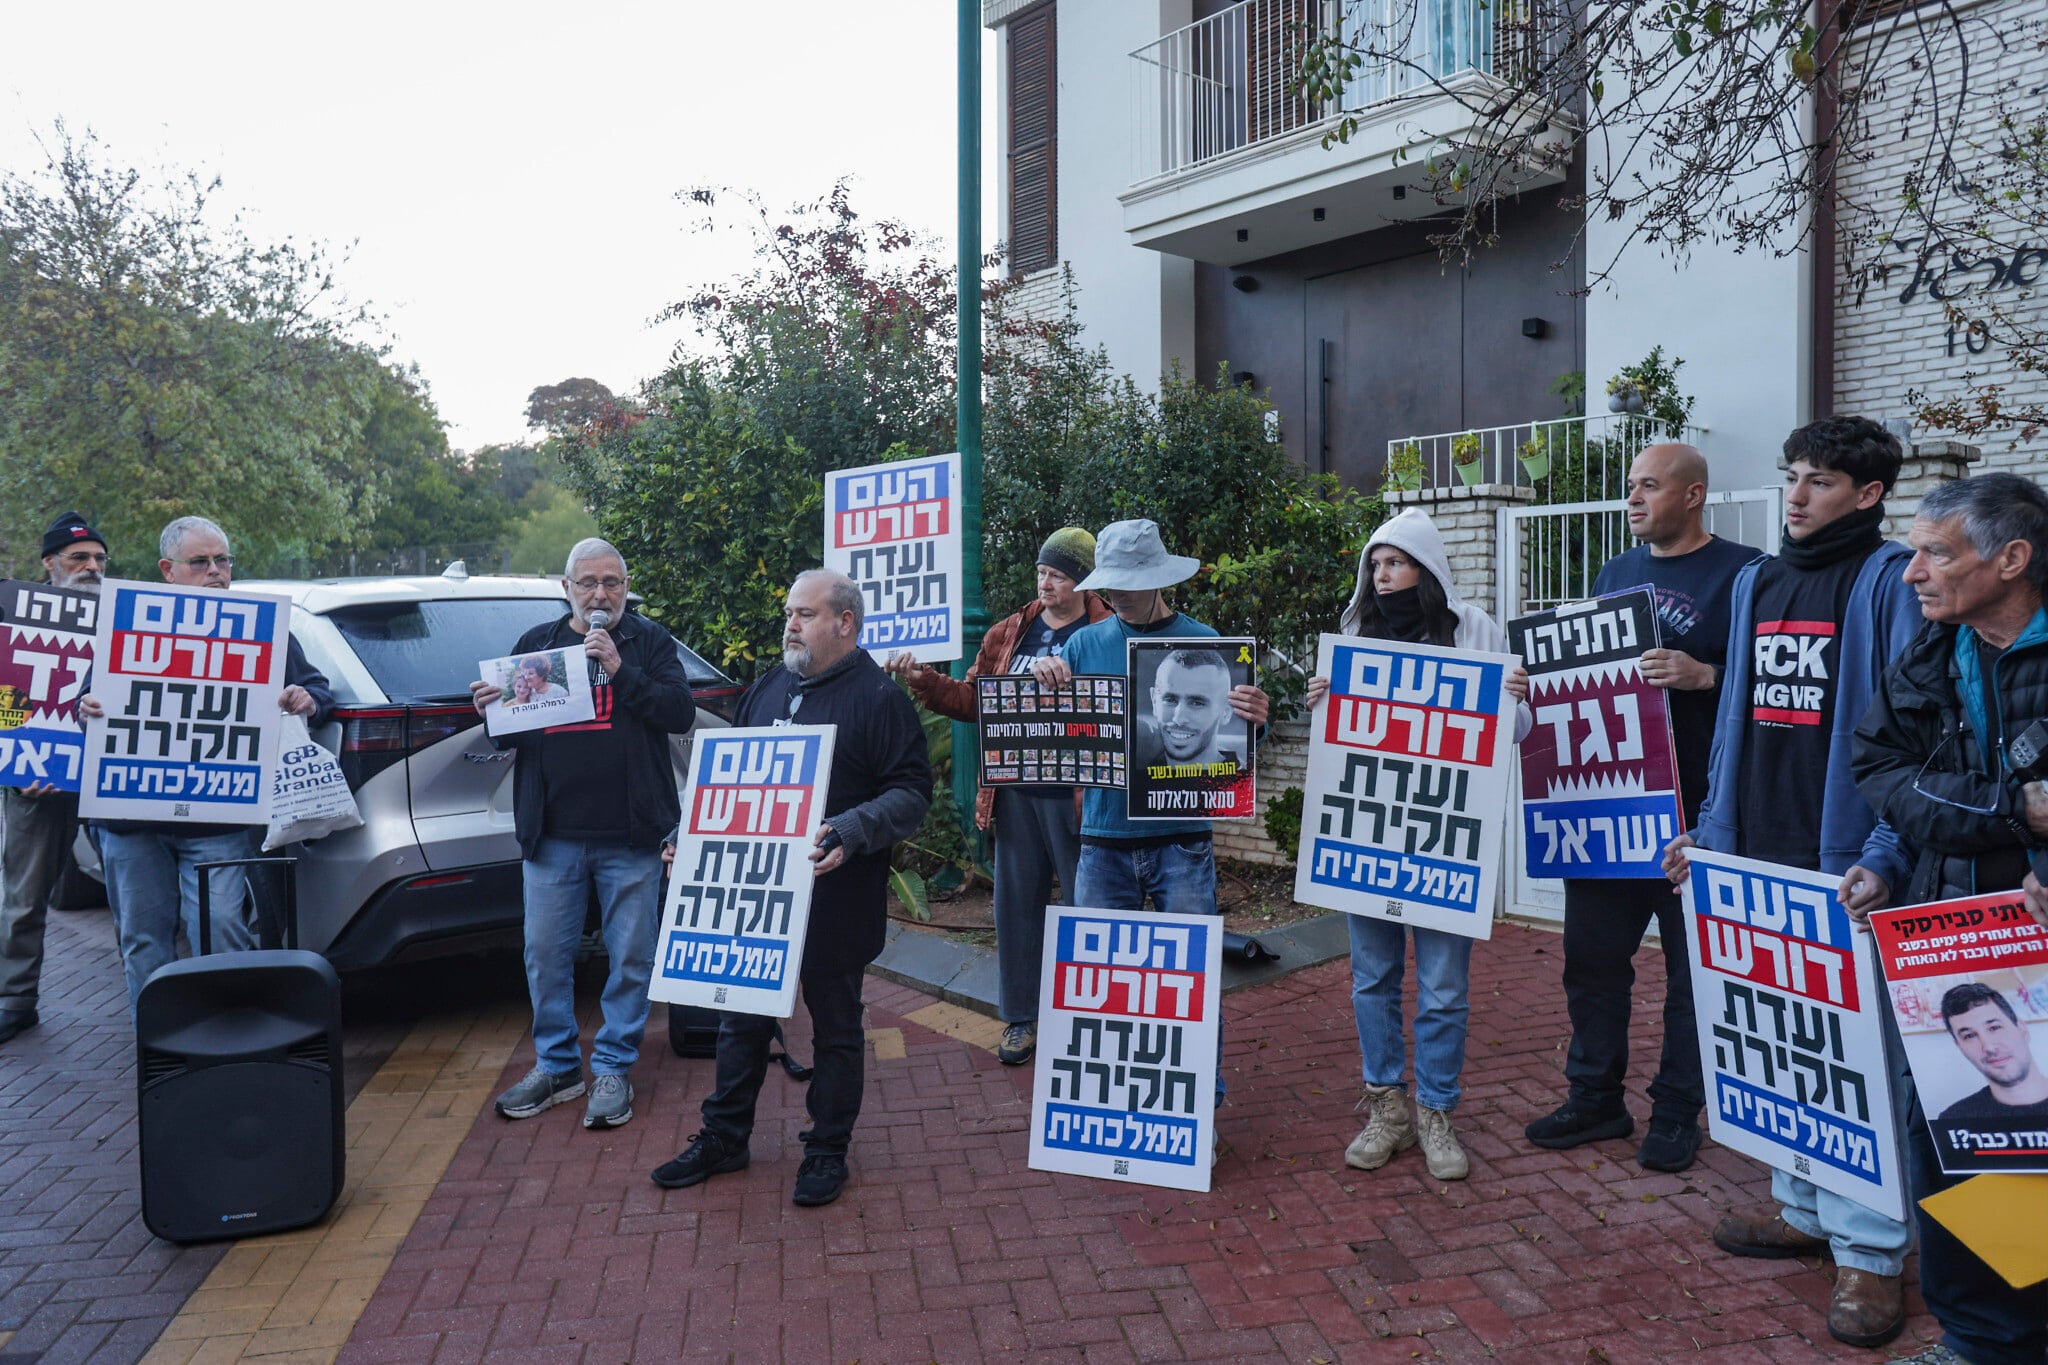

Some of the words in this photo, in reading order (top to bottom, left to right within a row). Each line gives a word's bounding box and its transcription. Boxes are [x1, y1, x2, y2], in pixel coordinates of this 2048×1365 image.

[1944, 320, 1989, 357] 10
[848, 466, 936, 510] העם
[842, 501, 942, 545] דורש
[848, 541, 934, 580] ועדת
[15, 589, 96, 628] ניהו
[859, 573, 947, 613] חקיר
[1655, 588, 1696, 603] NOWLEDGE
[132, 593, 259, 641] העם
[861, 614, 947, 645] ממלכת
[1524, 607, 1638, 666] נתניהו
[12, 649, 92, 705] גד
[121, 633, 262, 682] דורש
[1755, 634, 1832, 680] FCK
[124, 680, 249, 722] ועדת
[1348, 651, 1483, 712] העם
[512, 707, 520, 715] דן
[541, 698, 566, 709] כרמלה
[105, 718, 261, 763] חקירה
[986, 722, 1022, 738] הלחימה
[1023, 722, 1051, 738] המשך
[1053, 721, 1065, 736] על
[1066, 722, 1097, 738] בחייהם
[1099, 723, 1122, 739] שילמו
[1336, 698, 1486, 762] דורש
[1536, 693, 1645, 767] נגד
[282, 744, 319, 765] GB
[710, 739, 807, 785] העם
[1147, 765, 1173, 780] בשבי
[1205, 761, 1236, 778] הופקר
[101, 765, 257, 797] ממלכתית
[1147, 789, 1198, 811] טלאלקה
[1201, 790, 1235, 809] סמאר
[1339, 752, 1469, 812] ועדת
[697, 788, 805, 834] דורש
[1320, 794, 1482, 861] חקירה
[1533, 810, 1672, 864] ישראל
[694, 840, 789, 886] ועדת
[1315, 847, 1475, 905] ממלכתית
[674, 885, 794, 936] חקירה
[1706, 867, 1831, 945] העם
[1891, 908, 1985, 939] סבירסקי
[1988, 902, 2028, 922] יתי
[1072, 920, 1190, 970] העם
[1897, 938, 1930, 952] בשבי
[1930, 935, 1957, 948] ימים
[1959, 932, 1978, 944] 99
[1979, 928, 2013, 941] אחרי
[1990, 939, 2043, 960] הראשון
[2014, 923, 2048, 937] רצח
[667, 939, 785, 981] ממלכתית
[1706, 919, 1844, 1005] דורש
[1894, 953, 1939, 970] האחרון
[1940, 949, 1958, 962] לא
[1959, 946, 1989, 959] וכבר
[1063, 965, 1195, 1018] דורש
[1067, 1016, 1183, 1067] ועדת
[1723, 979, 1845, 1063] ועדת
[1050, 1058, 1196, 1113] חקירה
[1712, 1023, 1870, 1123] חקירה
[1047, 1111, 1193, 1157] ממלכתית
[1721, 1082, 1876, 1175] ממלכתית
